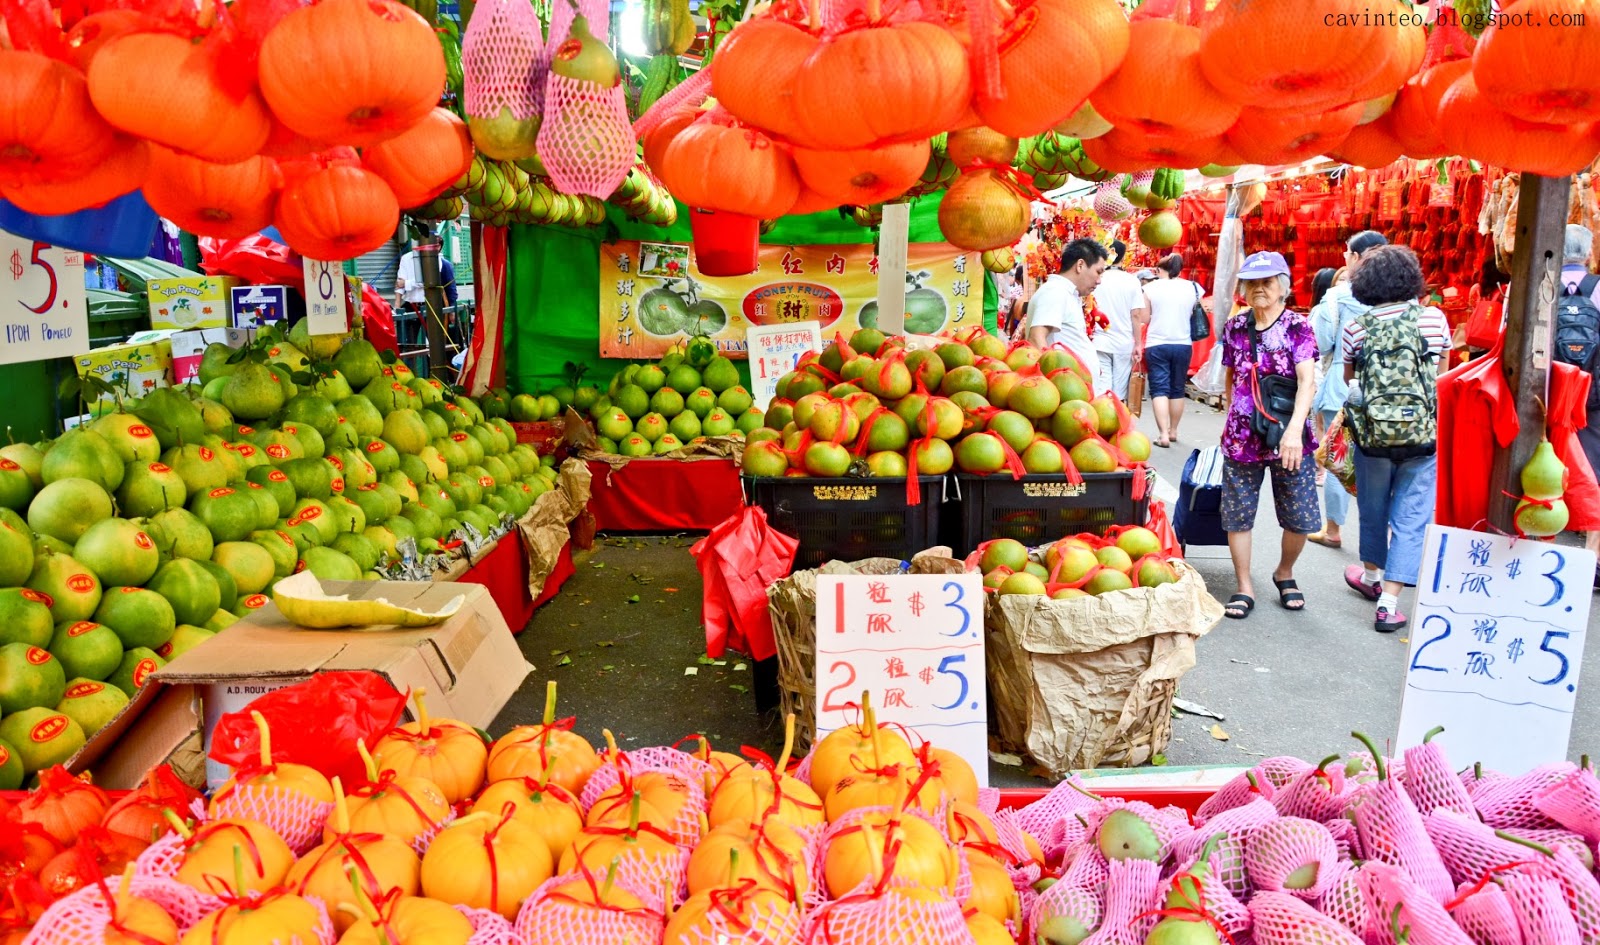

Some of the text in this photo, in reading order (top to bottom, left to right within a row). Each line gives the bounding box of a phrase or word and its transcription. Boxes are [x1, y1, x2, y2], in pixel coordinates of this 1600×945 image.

[178, 284, 203, 297] Pear
[755, 285, 831, 301] HONEY FRUIT
[952, 254, 971, 333] 香甜多
[782, 300, 803, 319] 甜
[6, 322, 73, 344] IPOH POMELO
[92, 360, 142, 375] Ya Pear
[244, 686, 266, 694] ROUX
